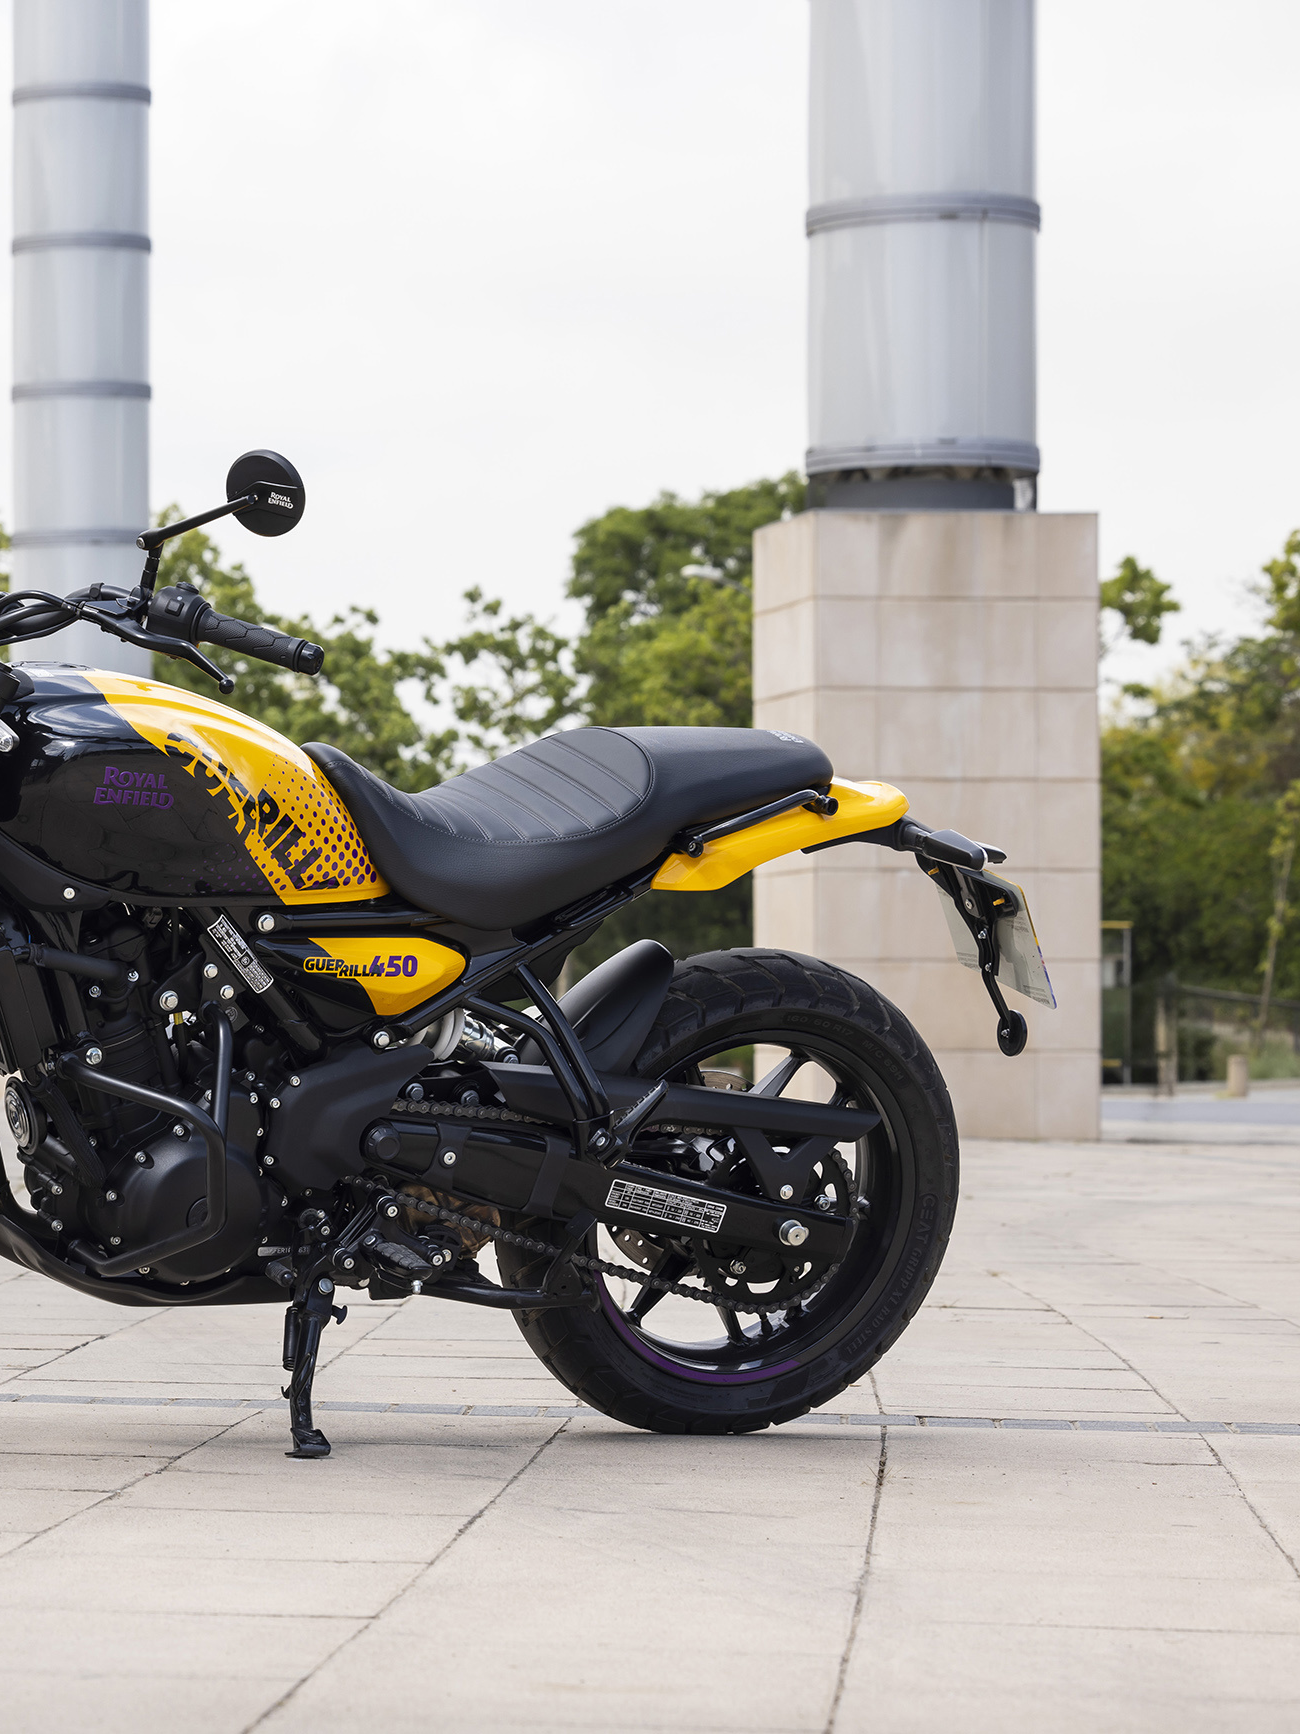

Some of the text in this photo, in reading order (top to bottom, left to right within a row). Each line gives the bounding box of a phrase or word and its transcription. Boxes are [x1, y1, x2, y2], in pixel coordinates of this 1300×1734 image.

[268, 497, 293, 509] ENFIELD
[271, 491, 291, 502] ROYAL
[103, 766, 168, 789] ROYAL
[93, 787, 175, 810] ENFIELD
[915, 1194, 937, 1245] CEAT
